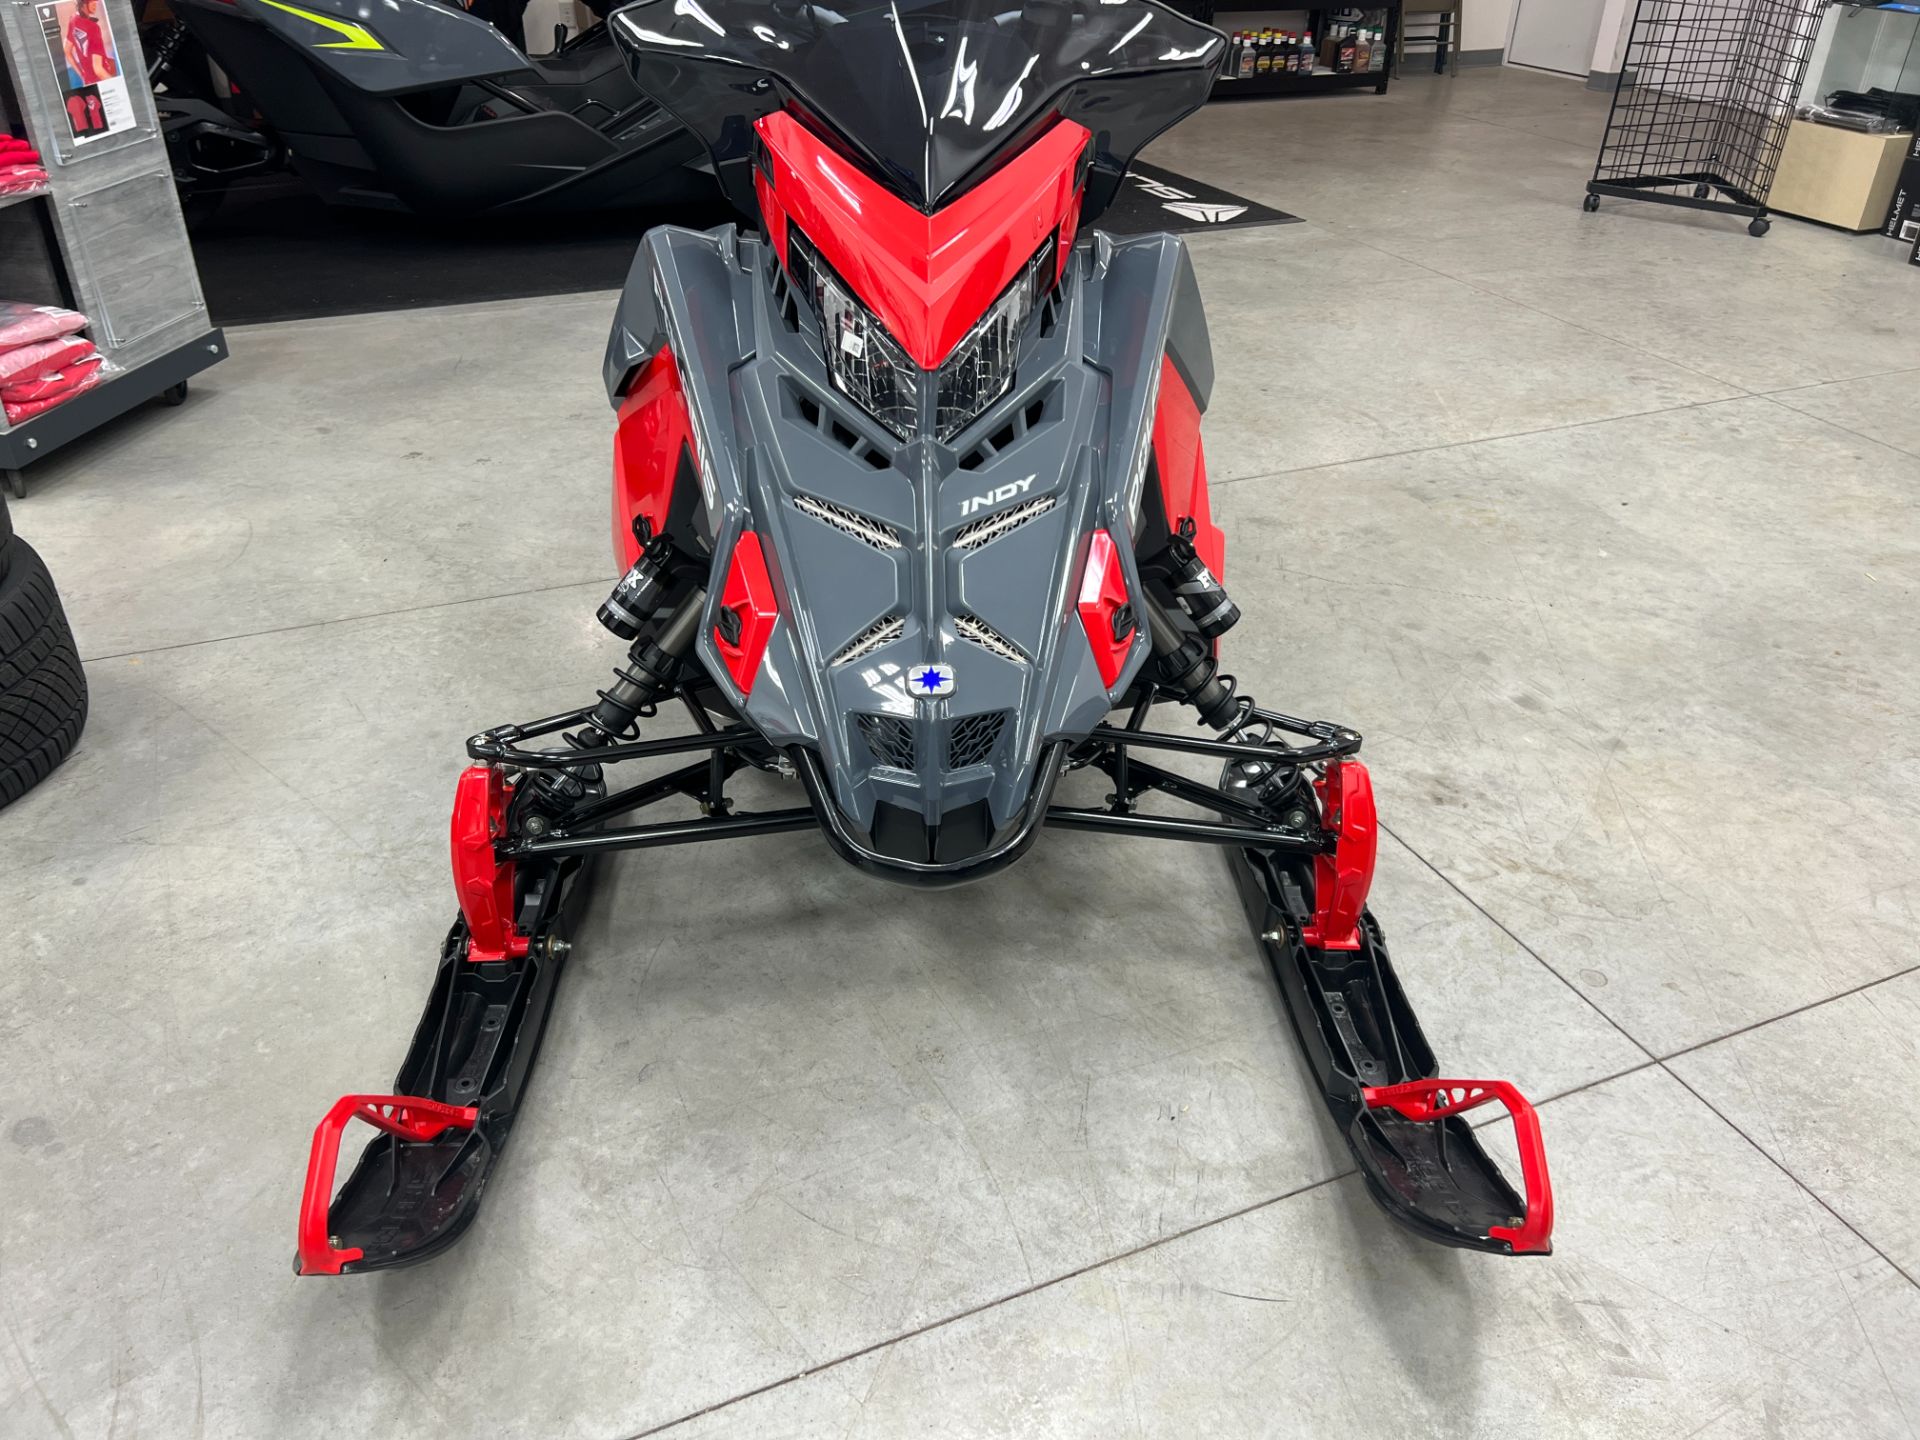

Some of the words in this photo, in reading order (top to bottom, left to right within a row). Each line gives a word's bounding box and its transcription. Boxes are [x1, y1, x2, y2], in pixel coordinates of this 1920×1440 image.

[1886, 189, 1907, 236] HELMET
[653, 267, 716, 511] POLARIS
[960, 473, 1037, 517] INDY
